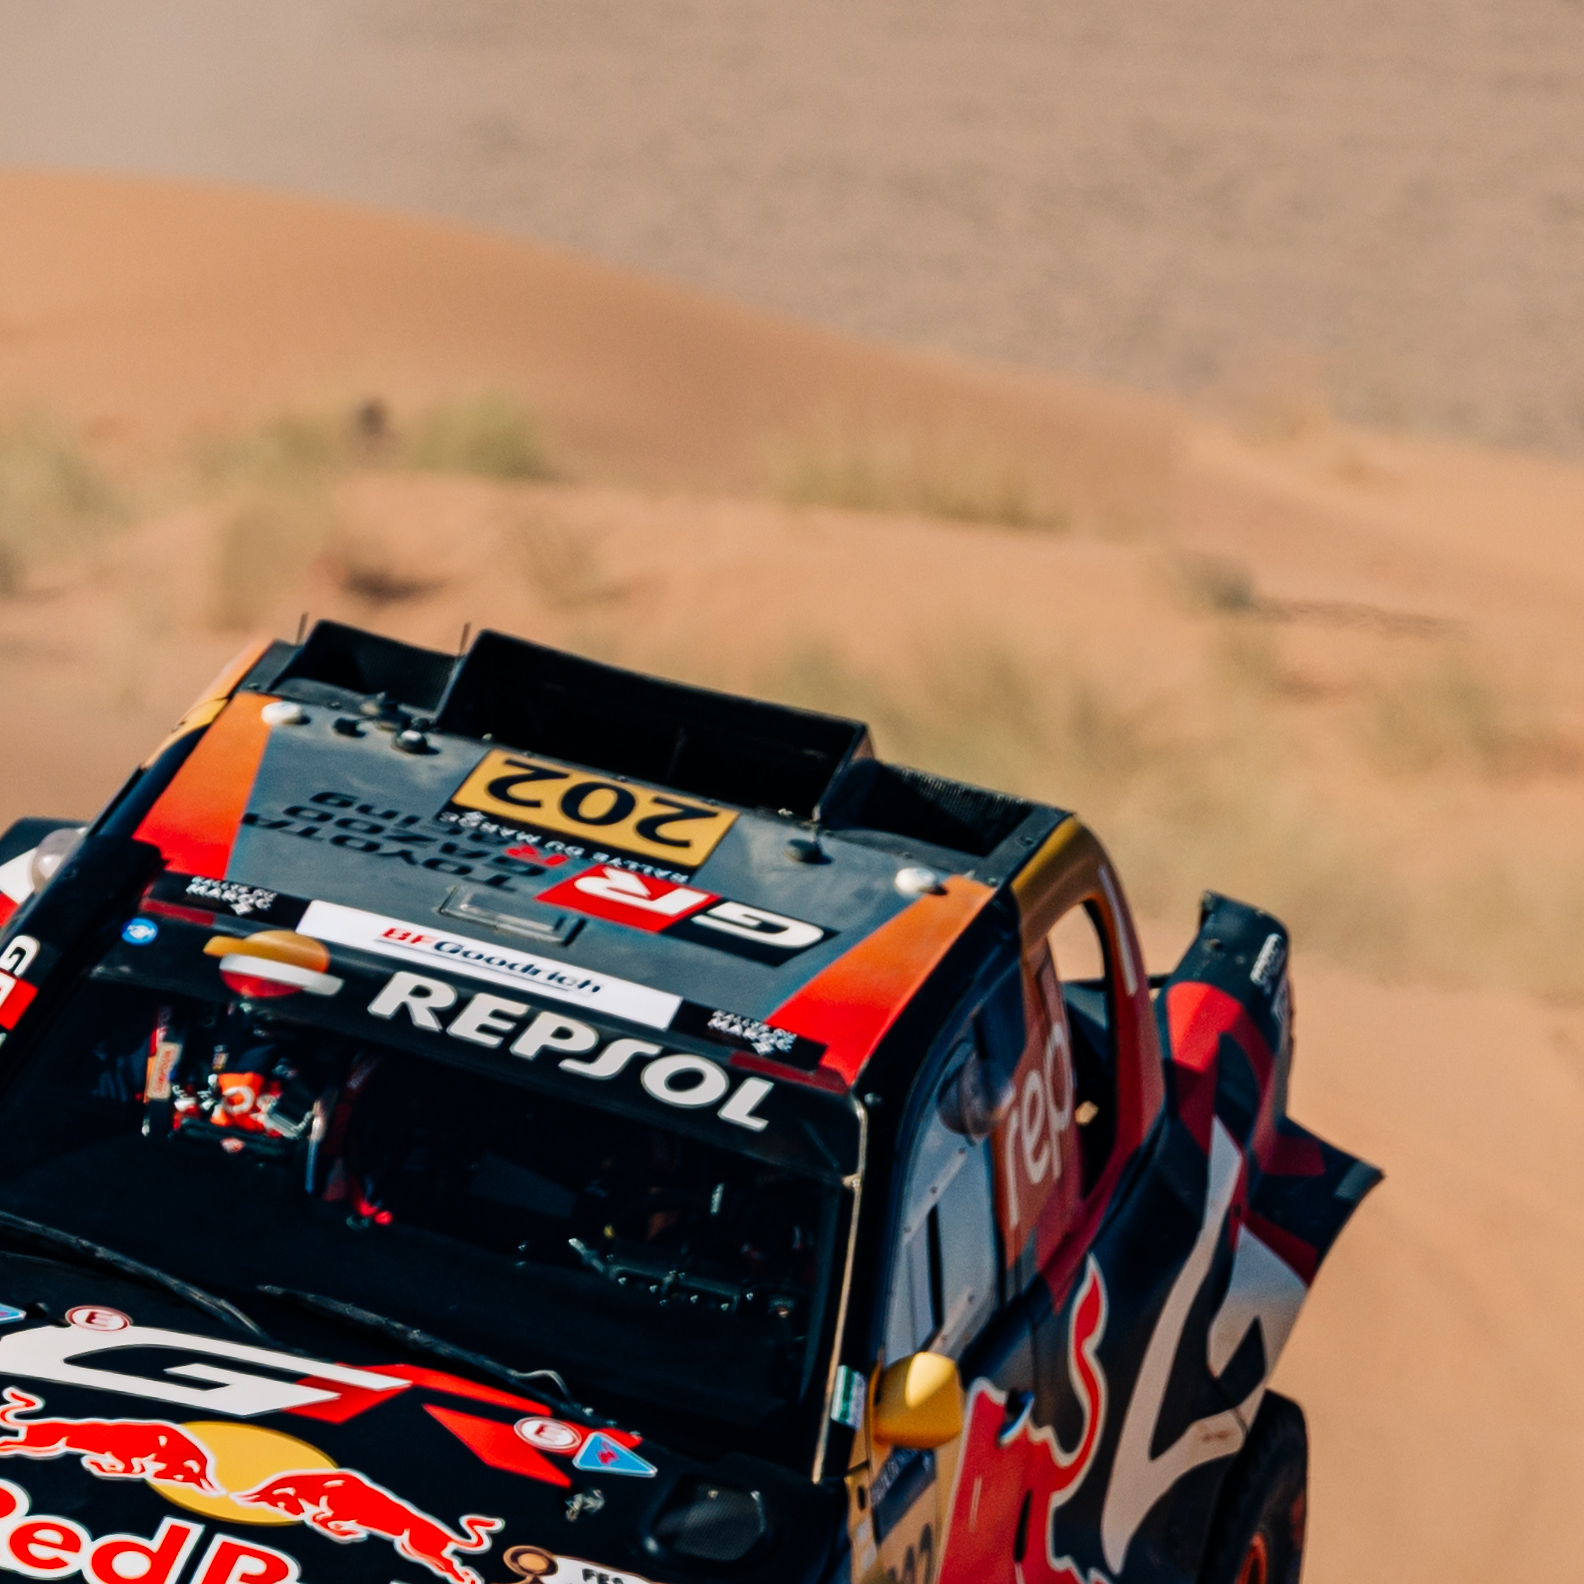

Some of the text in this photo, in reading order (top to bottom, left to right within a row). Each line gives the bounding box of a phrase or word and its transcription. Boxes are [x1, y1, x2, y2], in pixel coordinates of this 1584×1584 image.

[282, 805, 547, 877] GAZOO
[486, 758, 719, 848] 202
[242, 812, 519, 893] TOYOTA
[573, 866, 825, 950] GR
[378, 926, 603, 996] BFGoodrich
[367, 970, 774, 1131] REPSOL
